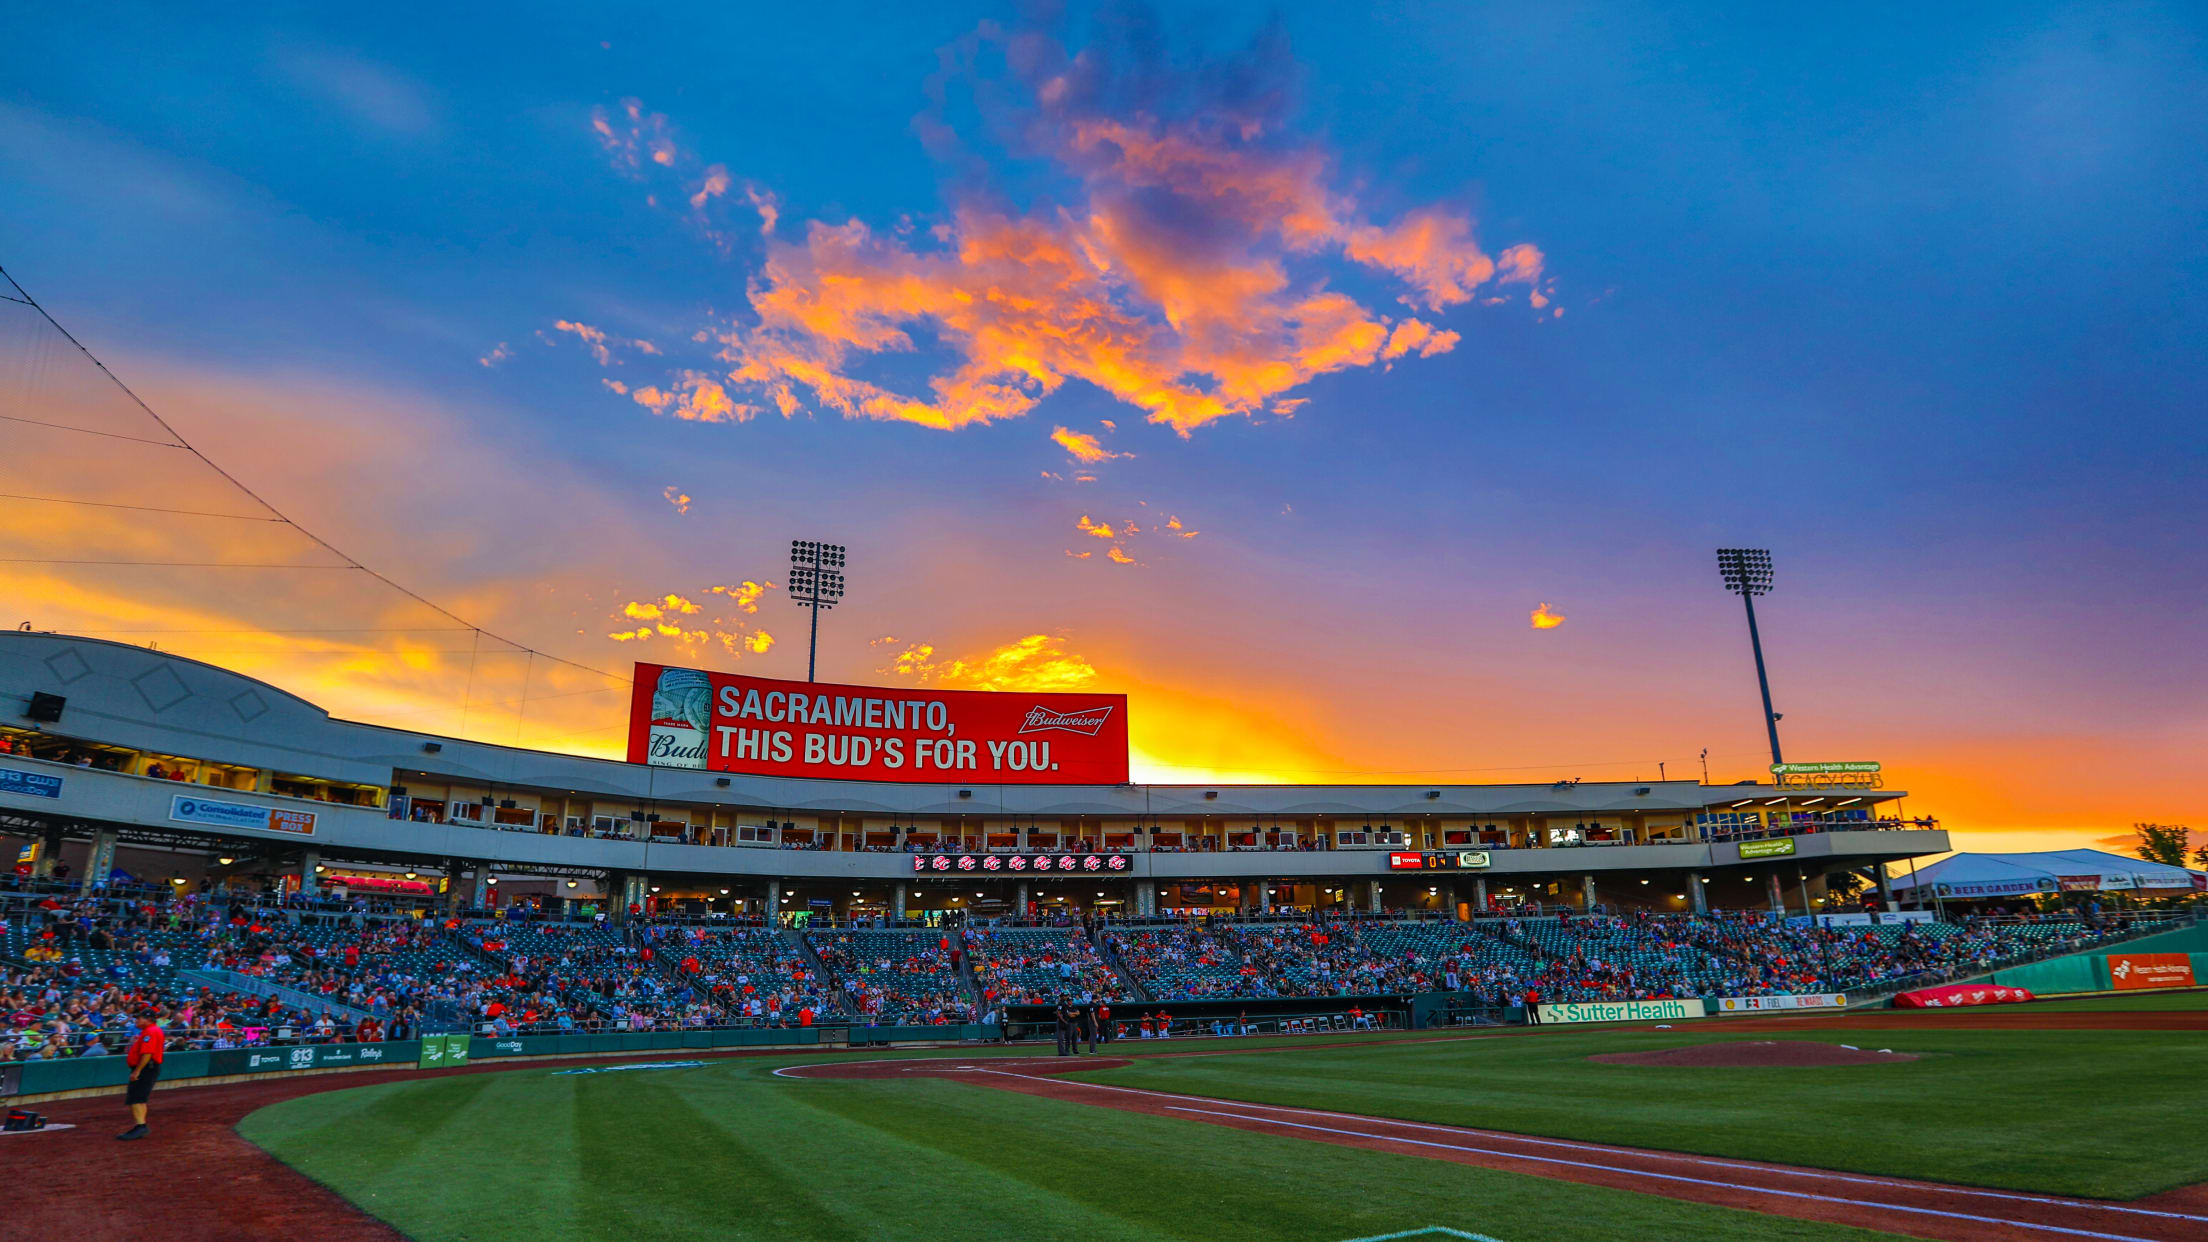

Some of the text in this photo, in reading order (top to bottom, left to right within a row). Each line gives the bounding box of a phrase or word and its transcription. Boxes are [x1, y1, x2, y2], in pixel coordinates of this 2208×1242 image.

[718, 686, 955, 736] SACRAMENTO,
[1025, 711, 1103, 727] Budweiser
[716, 725, 1059, 771] THIS BUD'S FOR YOU.
[1845, 763, 1879, 772] Advantage
[1772, 773, 1884, 791] LEGACY CLUB
[200, 803, 265, 819] Consolidated
[275, 811, 312, 824] PRESS
[280, 821, 303, 832] BOX
[1429, 856, 1437, 868] 0
[1955, 882, 2034, 894] BEER GARDEN
[1767, 998, 1781, 1008] FUEL
[1796, 996, 1824, 1007] REWARDS
[1567, 1000, 1686, 1021] Sutter Health
[360, 1048, 382, 1060] Raley's
